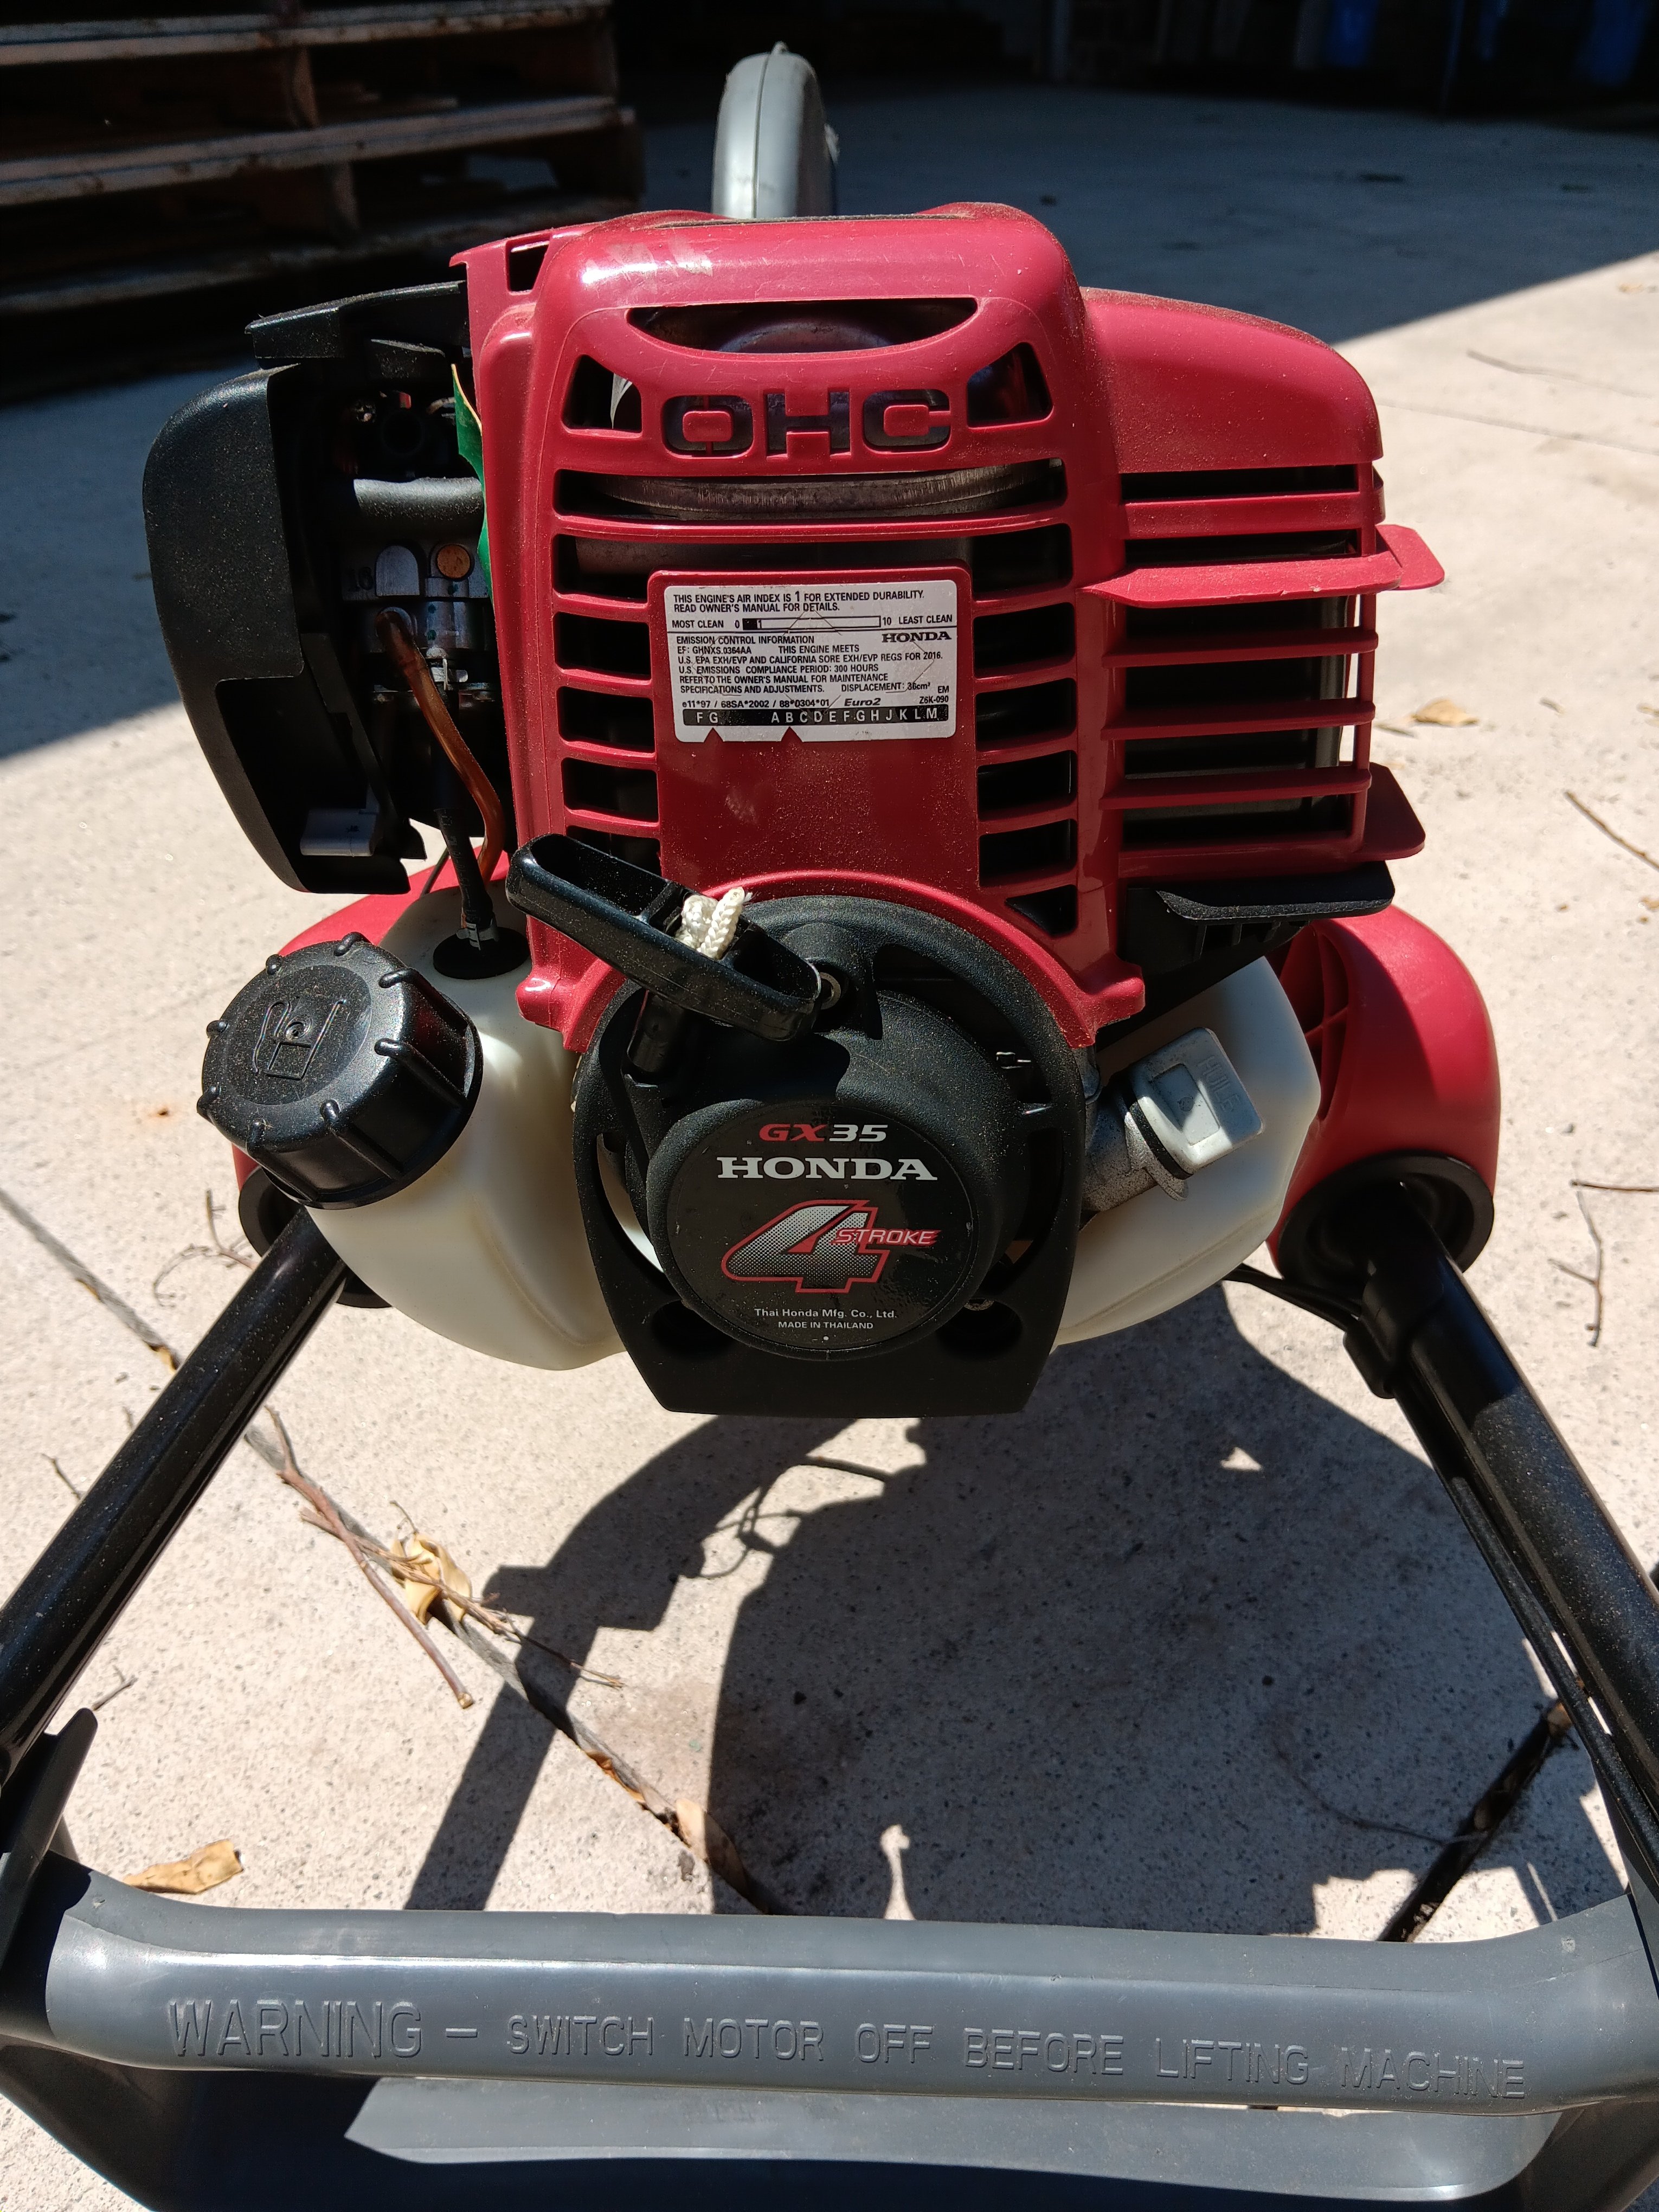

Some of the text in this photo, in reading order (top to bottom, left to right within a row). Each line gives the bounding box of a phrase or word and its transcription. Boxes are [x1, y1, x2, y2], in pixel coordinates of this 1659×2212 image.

[662, 388, 951, 459] OHC
[673, 590, 924, 603] THIS ENGINE'S AIR INDEX IS 1 FOR EXTENDED DURABILITY.
[674, 602, 840, 613] READ OWNER'S MANUAL FOR DETAILS.
[672, 620, 695, 628] MOST
[698, 620, 724, 628] CLEAN
[882, 617, 891, 626] 10
[898, 615, 923, 624] LEAST
[926, 614, 953, 623] CLEAN
[677, 635, 814, 645] EMISSION CONTROL INFORMATION
[882, 631, 951, 643] HONDA
[677, 646, 690, 654] EF:
[779, 645, 859, 654] THIS ENGINE MEETS
[696, 656, 710, 664] EPA
[713, 656, 747, 665] EXH/EVP
[769, 655, 816, 664] CALIFORNIA
[819, 654, 840, 663] SORE
[843, 654, 878, 663] EXH/EVP
[881, 653, 902, 661] REGS
[905, 652, 921, 660] FOR
[923, 652, 943, 660] 2016.
[679, 666, 693, 674] U.S.
[697, 666, 740, 674] EMISSIONS
[745, 665, 797, 674] COMPLIANCE
[800, 665, 832, 673] PERIOD:
[850, 664, 879, 672] HOURS
[734, 676, 770, 684] OWNER'S
[773, 675, 808, 683] MANUAL
[811, 674, 827, 683] FOR
[829, 673, 888, 683] MAINTENANCE
[680, 684, 825, 693] SPECIFICATIONS AND ADJUSTMENTS.
[841, 683, 904, 692] DISPLACEMENT:
[938, 685, 949, 693] EM
[844, 698, 881, 706] Euro2
[697, 708, 937, 723] F G A B C D E F G H J K L M
[1196, 1055, 1242, 1113] HUILE
[759, 1123, 888, 1142] GX35
[717, 1156, 937, 1181] HONDA
[833, 1228, 940, 1245] STROKE
[754, 1308, 897, 1319] Thai Honda Mfg. Co., Ltd.
[168, 1998, 422, 2059] WARNING
[506, 2015, 654, 2056] SWITCH
[684, 2017, 825, 2061] MOTOR
[855, 2022, 933, 2064] OFF
[963, 2027, 1124, 2075] BEFORE
[1155, 2037, 1309, 2085] LIFTING
[1341, 2047, 1525, 2099] MACHINE
